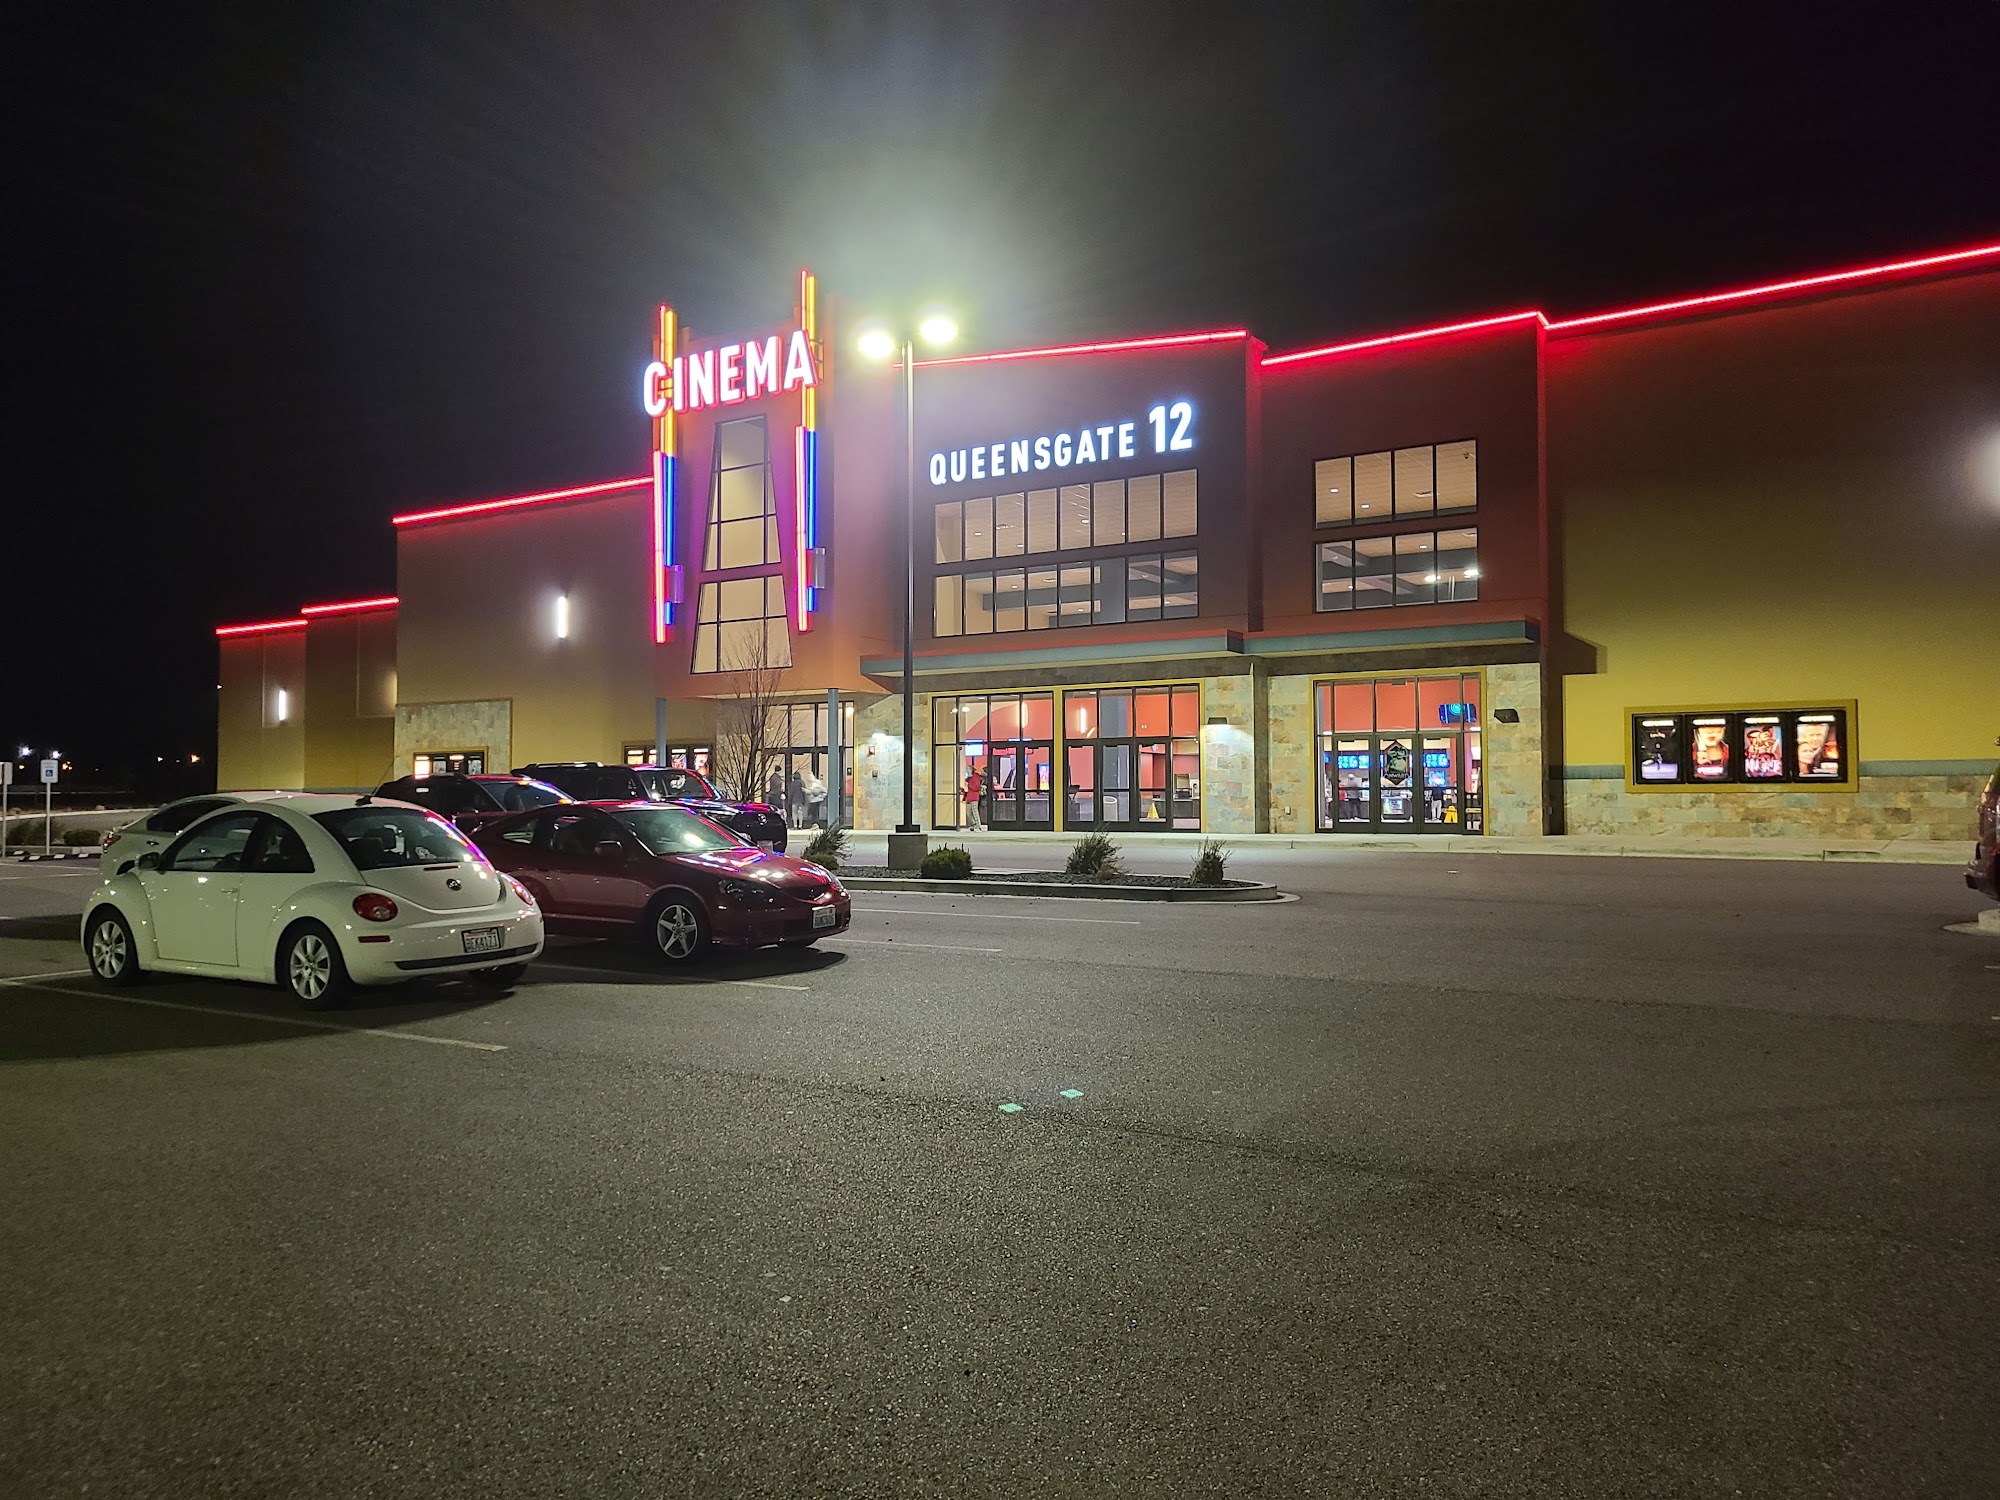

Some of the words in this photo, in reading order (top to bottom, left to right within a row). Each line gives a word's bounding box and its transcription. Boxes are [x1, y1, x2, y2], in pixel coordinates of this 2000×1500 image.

[643, 329, 817, 418] CINEMA
[929, 422, 1136, 486] QUEENSGATE
[1148, 401, 1194, 454] 12
